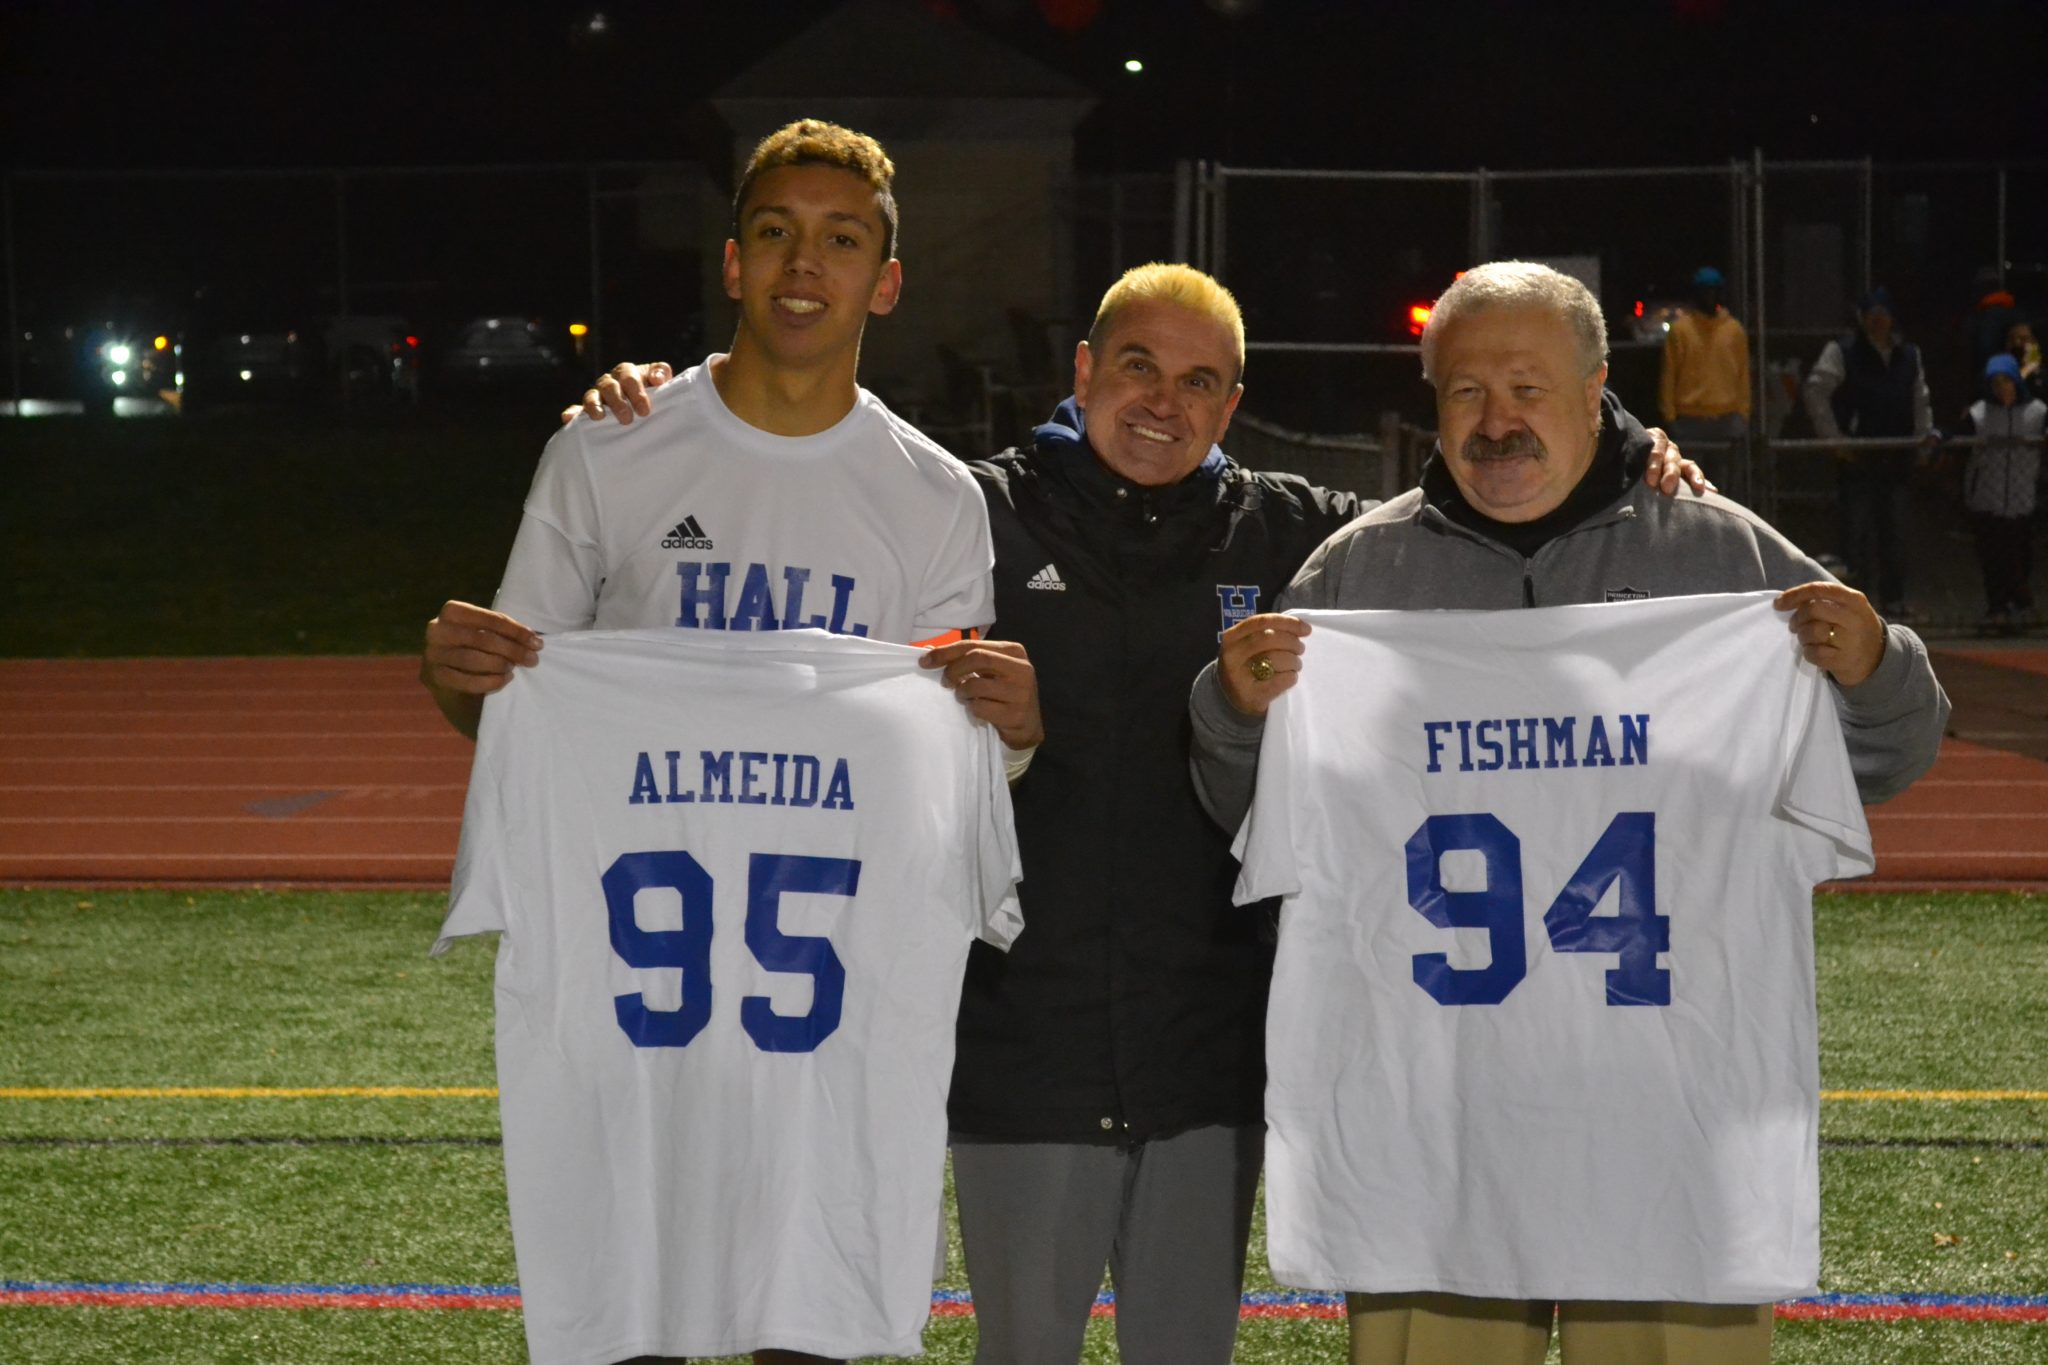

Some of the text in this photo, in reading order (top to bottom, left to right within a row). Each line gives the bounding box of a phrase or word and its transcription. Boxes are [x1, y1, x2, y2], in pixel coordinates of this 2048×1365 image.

[661, 537, 713, 550] adidas
[675, 561, 868, 638] HALL
[1027, 580, 1066, 591] adidas
[1424, 714, 1651, 772] FISHMAN
[629, 751, 854, 810] ALMEIDA
[1405, 812, 1671, 1006] 94
[602, 850, 862, 1053] 95
